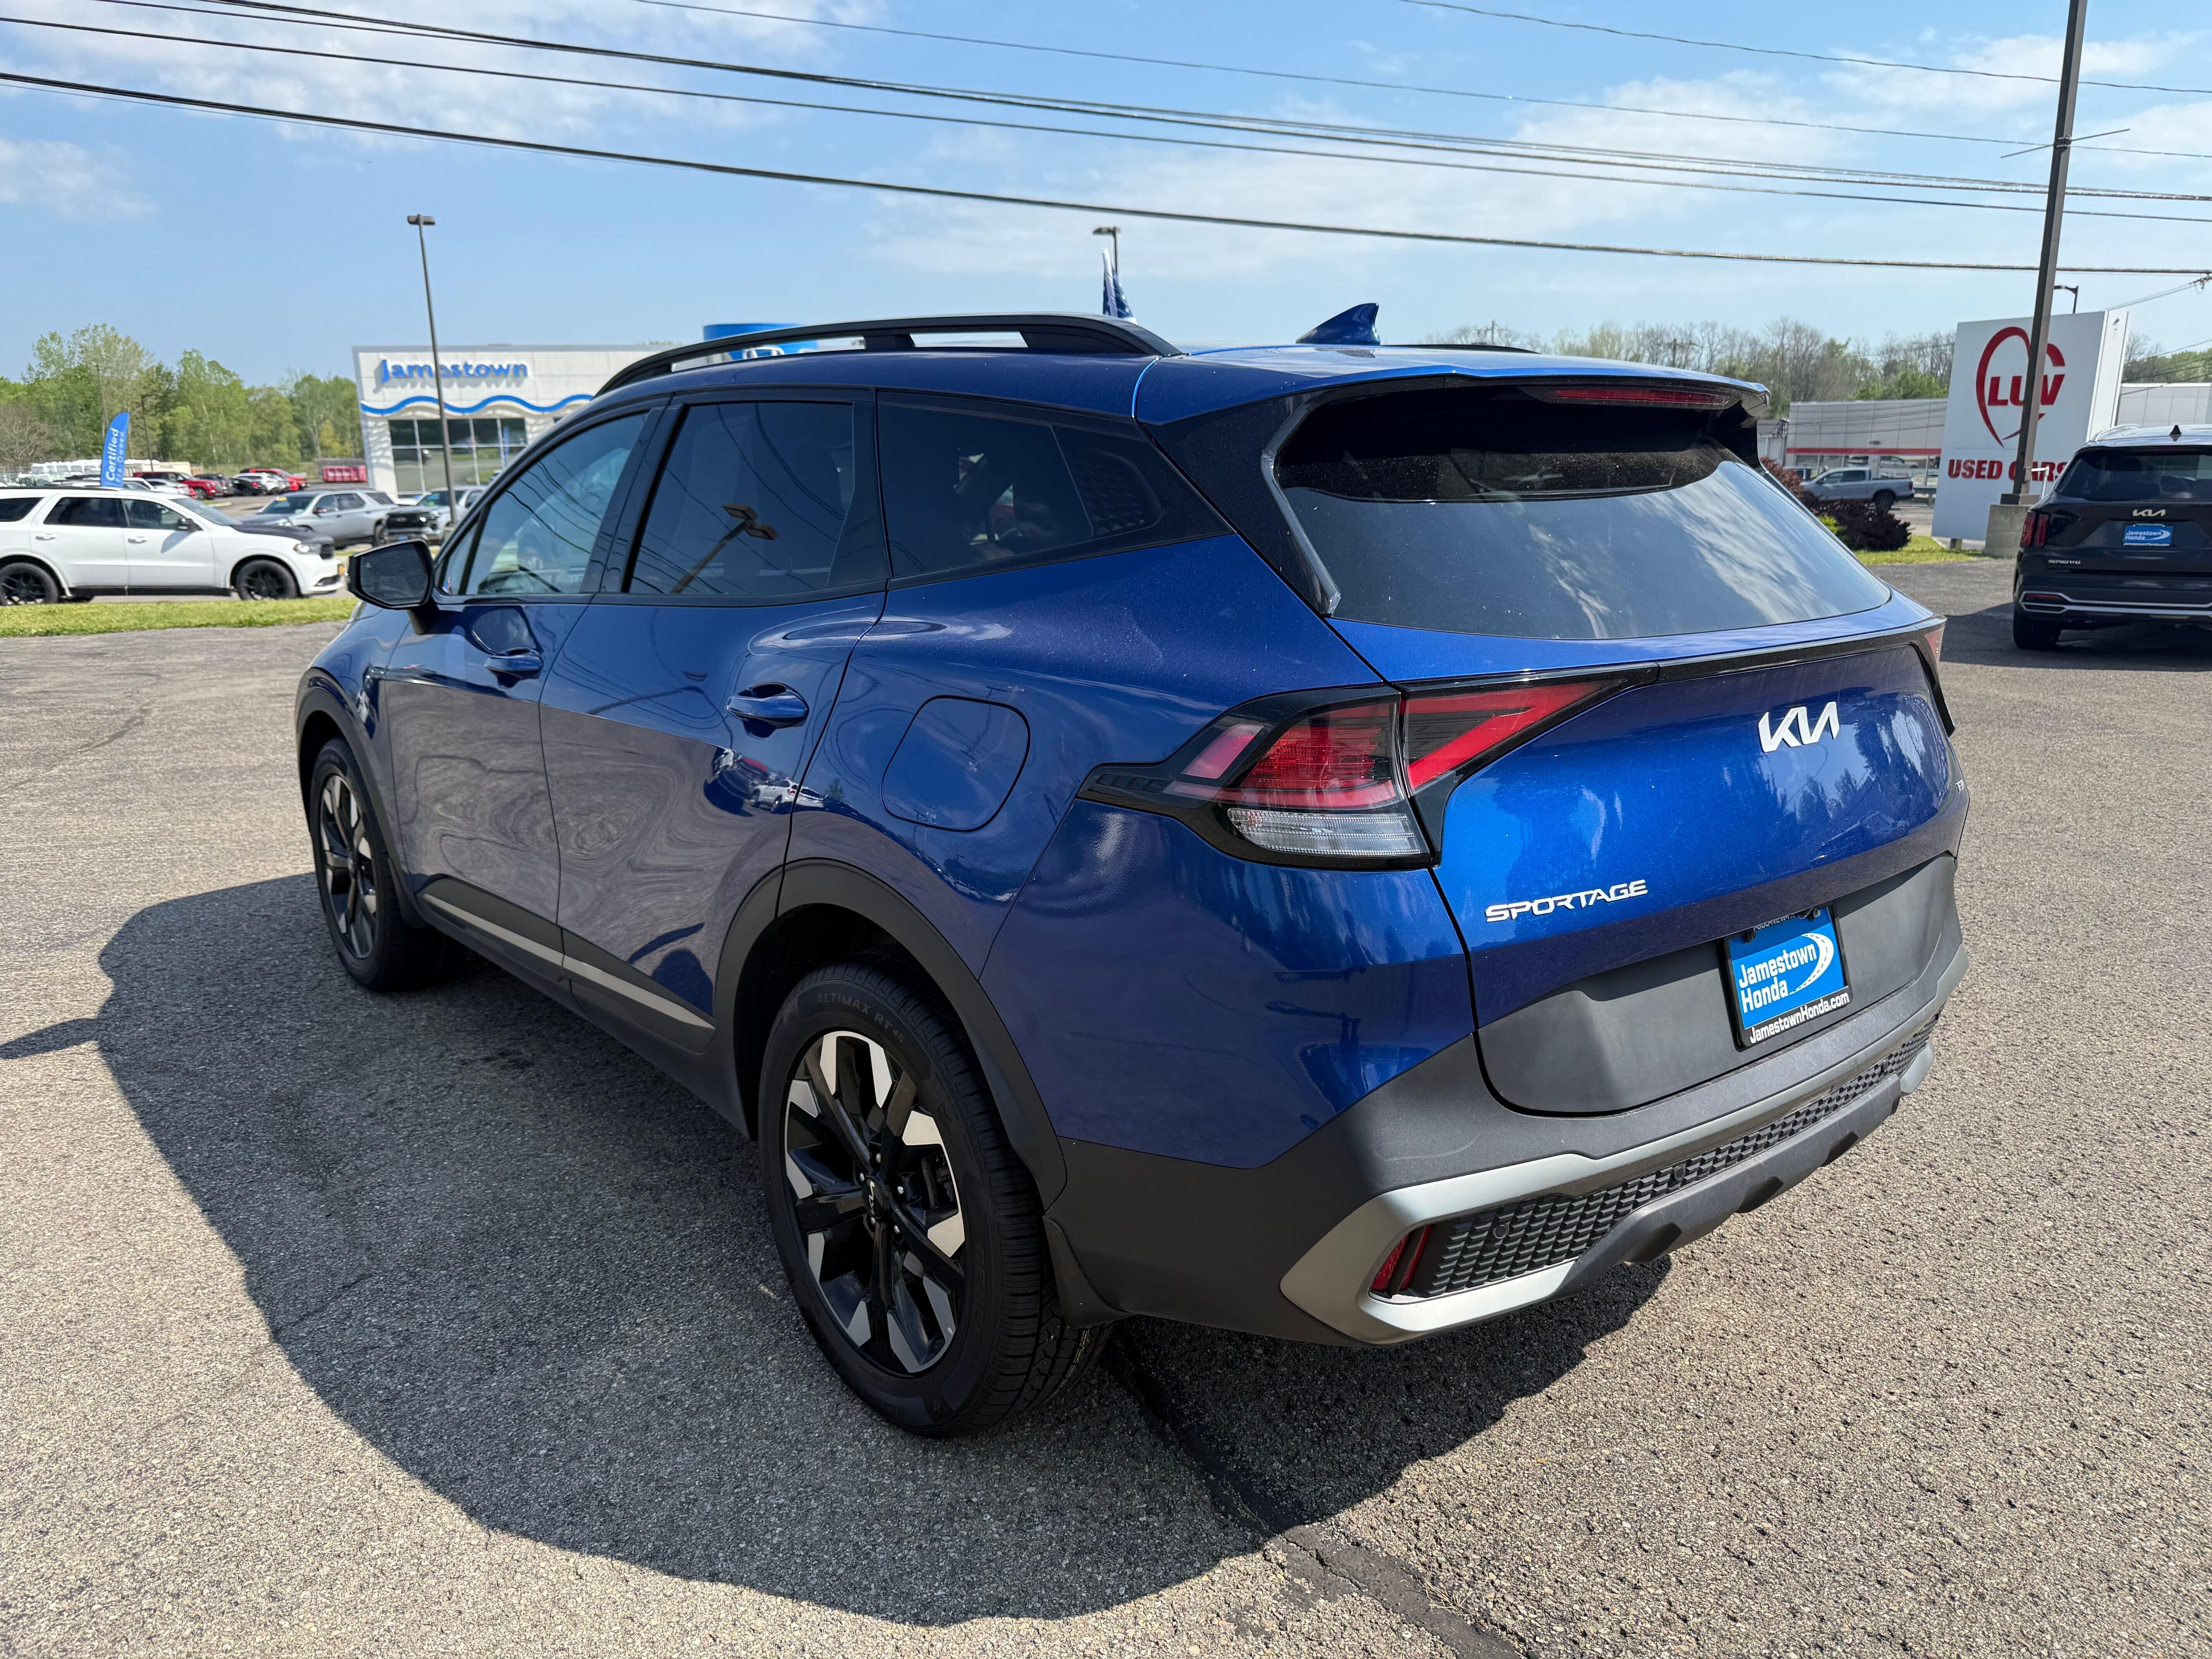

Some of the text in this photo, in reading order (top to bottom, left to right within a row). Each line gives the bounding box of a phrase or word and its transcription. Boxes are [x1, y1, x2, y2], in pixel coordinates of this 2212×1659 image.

[381, 359, 528, 383] Jamestown
[106, 427, 119, 481] Certified
[1948, 459, 2003, 480] USED
[1758, 701, 1839, 752] KIA
[1485, 879, 1648, 922] SPORTAGE
[1738, 943, 1817, 988] Jamestown
[816, 993, 871, 1015] ALTIMAX
[1740, 976, 1788, 1013] Honda
[1750, 992, 1850, 1044] JamestownHonda.com
